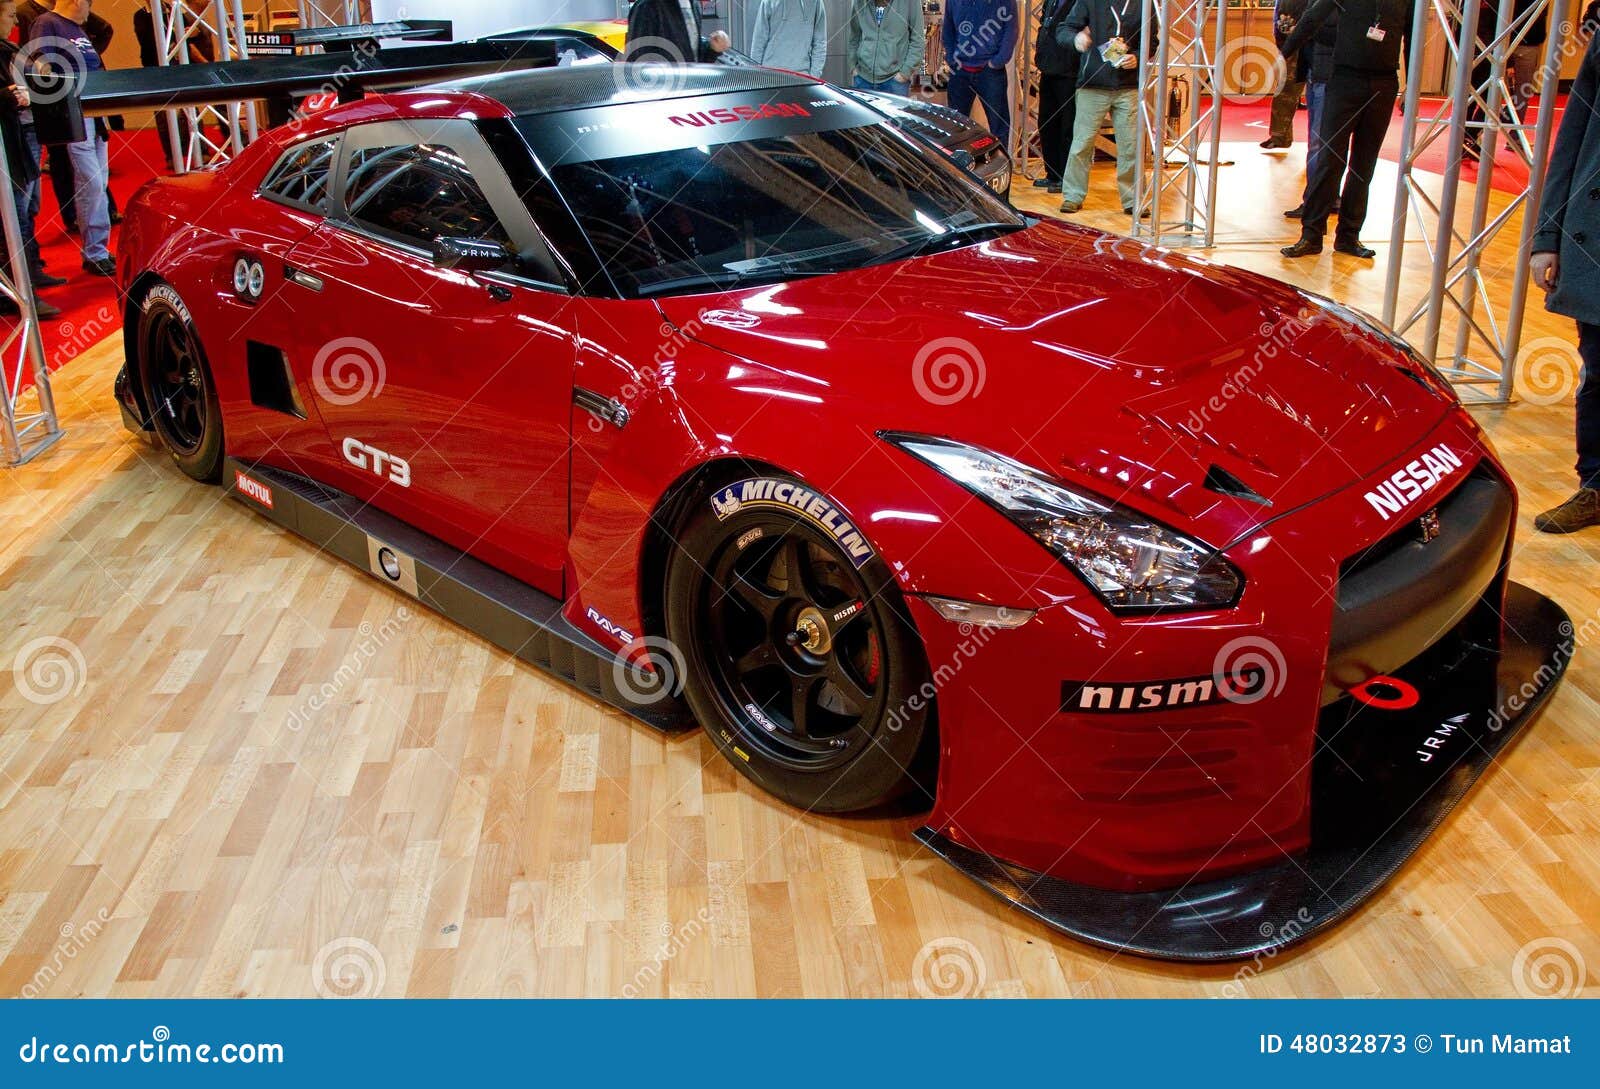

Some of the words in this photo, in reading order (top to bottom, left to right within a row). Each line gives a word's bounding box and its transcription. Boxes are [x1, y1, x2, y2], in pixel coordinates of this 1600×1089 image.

[667, 102, 811, 127] NISSAN
[149, 286, 192, 322] MICHELIN
[343, 437, 411, 488] GT3
[1363, 443, 1463, 521] NISSAN
[238, 474, 273, 506] MOTUL
[741, 480, 870, 558] MICHELIN
[587, 606, 635, 645] RAYS
[1416, 723, 1458, 762] JRM
